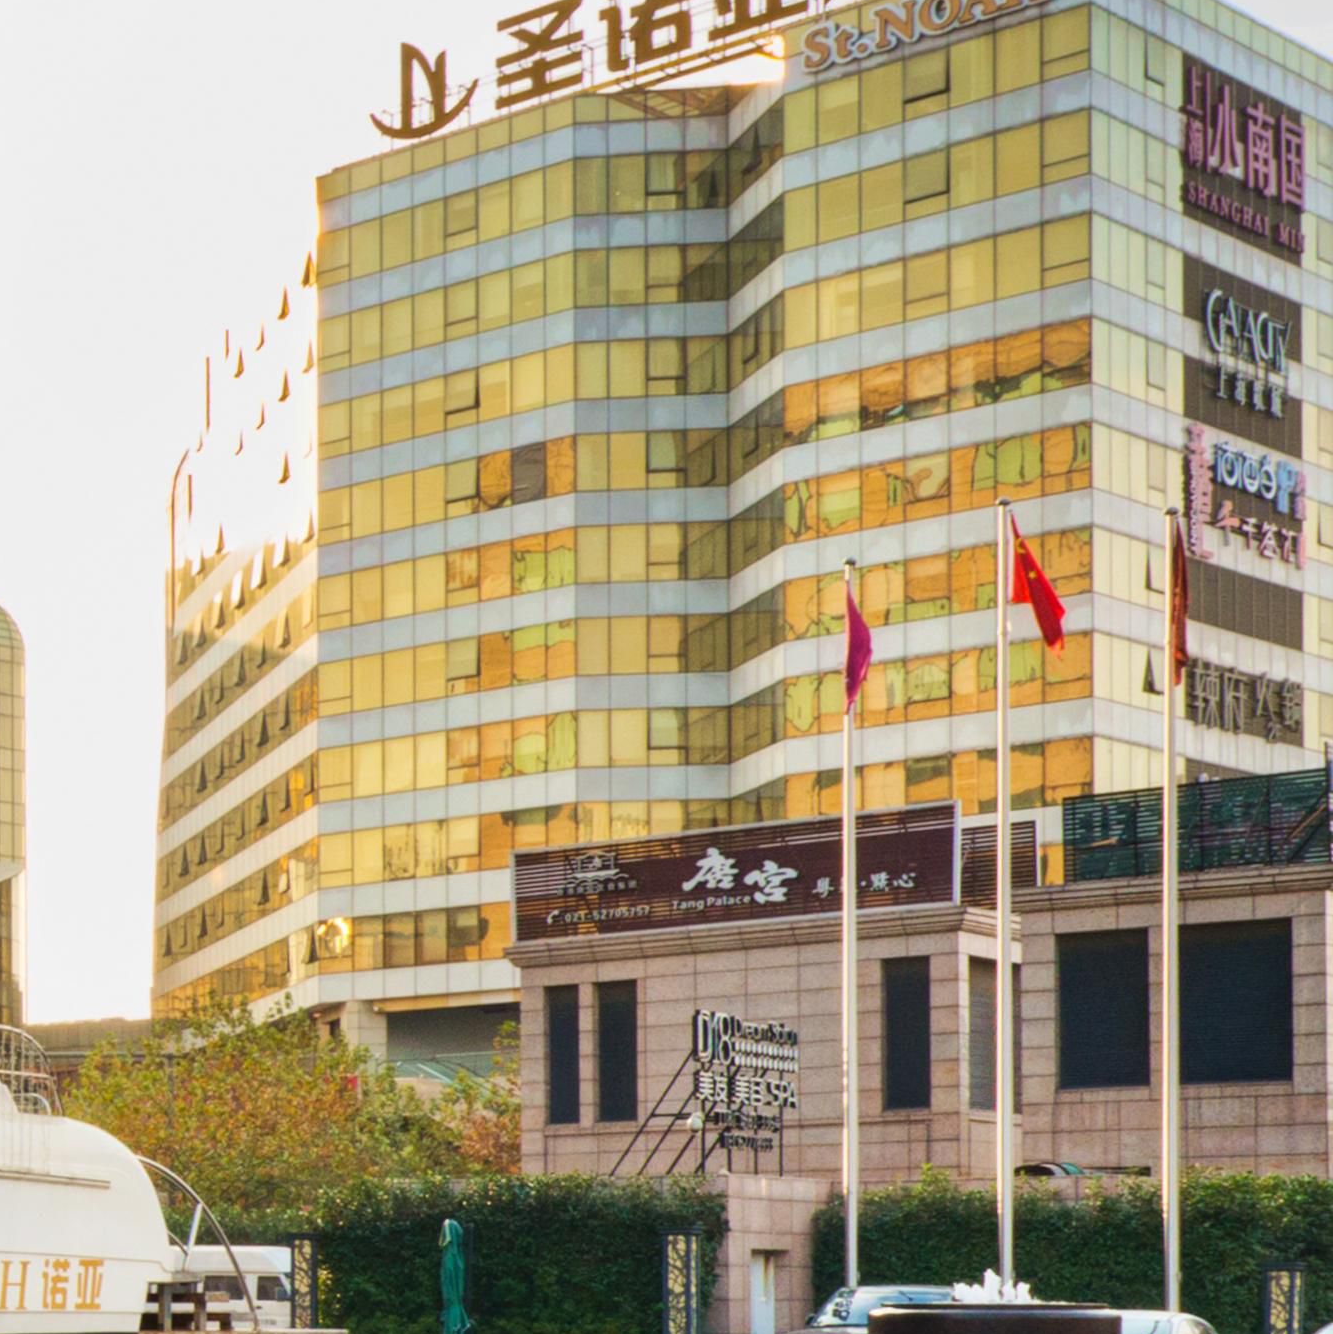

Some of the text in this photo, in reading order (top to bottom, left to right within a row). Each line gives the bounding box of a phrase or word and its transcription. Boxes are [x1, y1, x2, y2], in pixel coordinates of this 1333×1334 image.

[1212, 85, 1306, 214] 小南国
[1187, 180, 1306, 255] SHANGHAI MIN
[672, 894, 751, 911] Tang Palace
[769, 1078, 799, 1108] SPA
[41, 1258, 105, 1310] 诺亚
